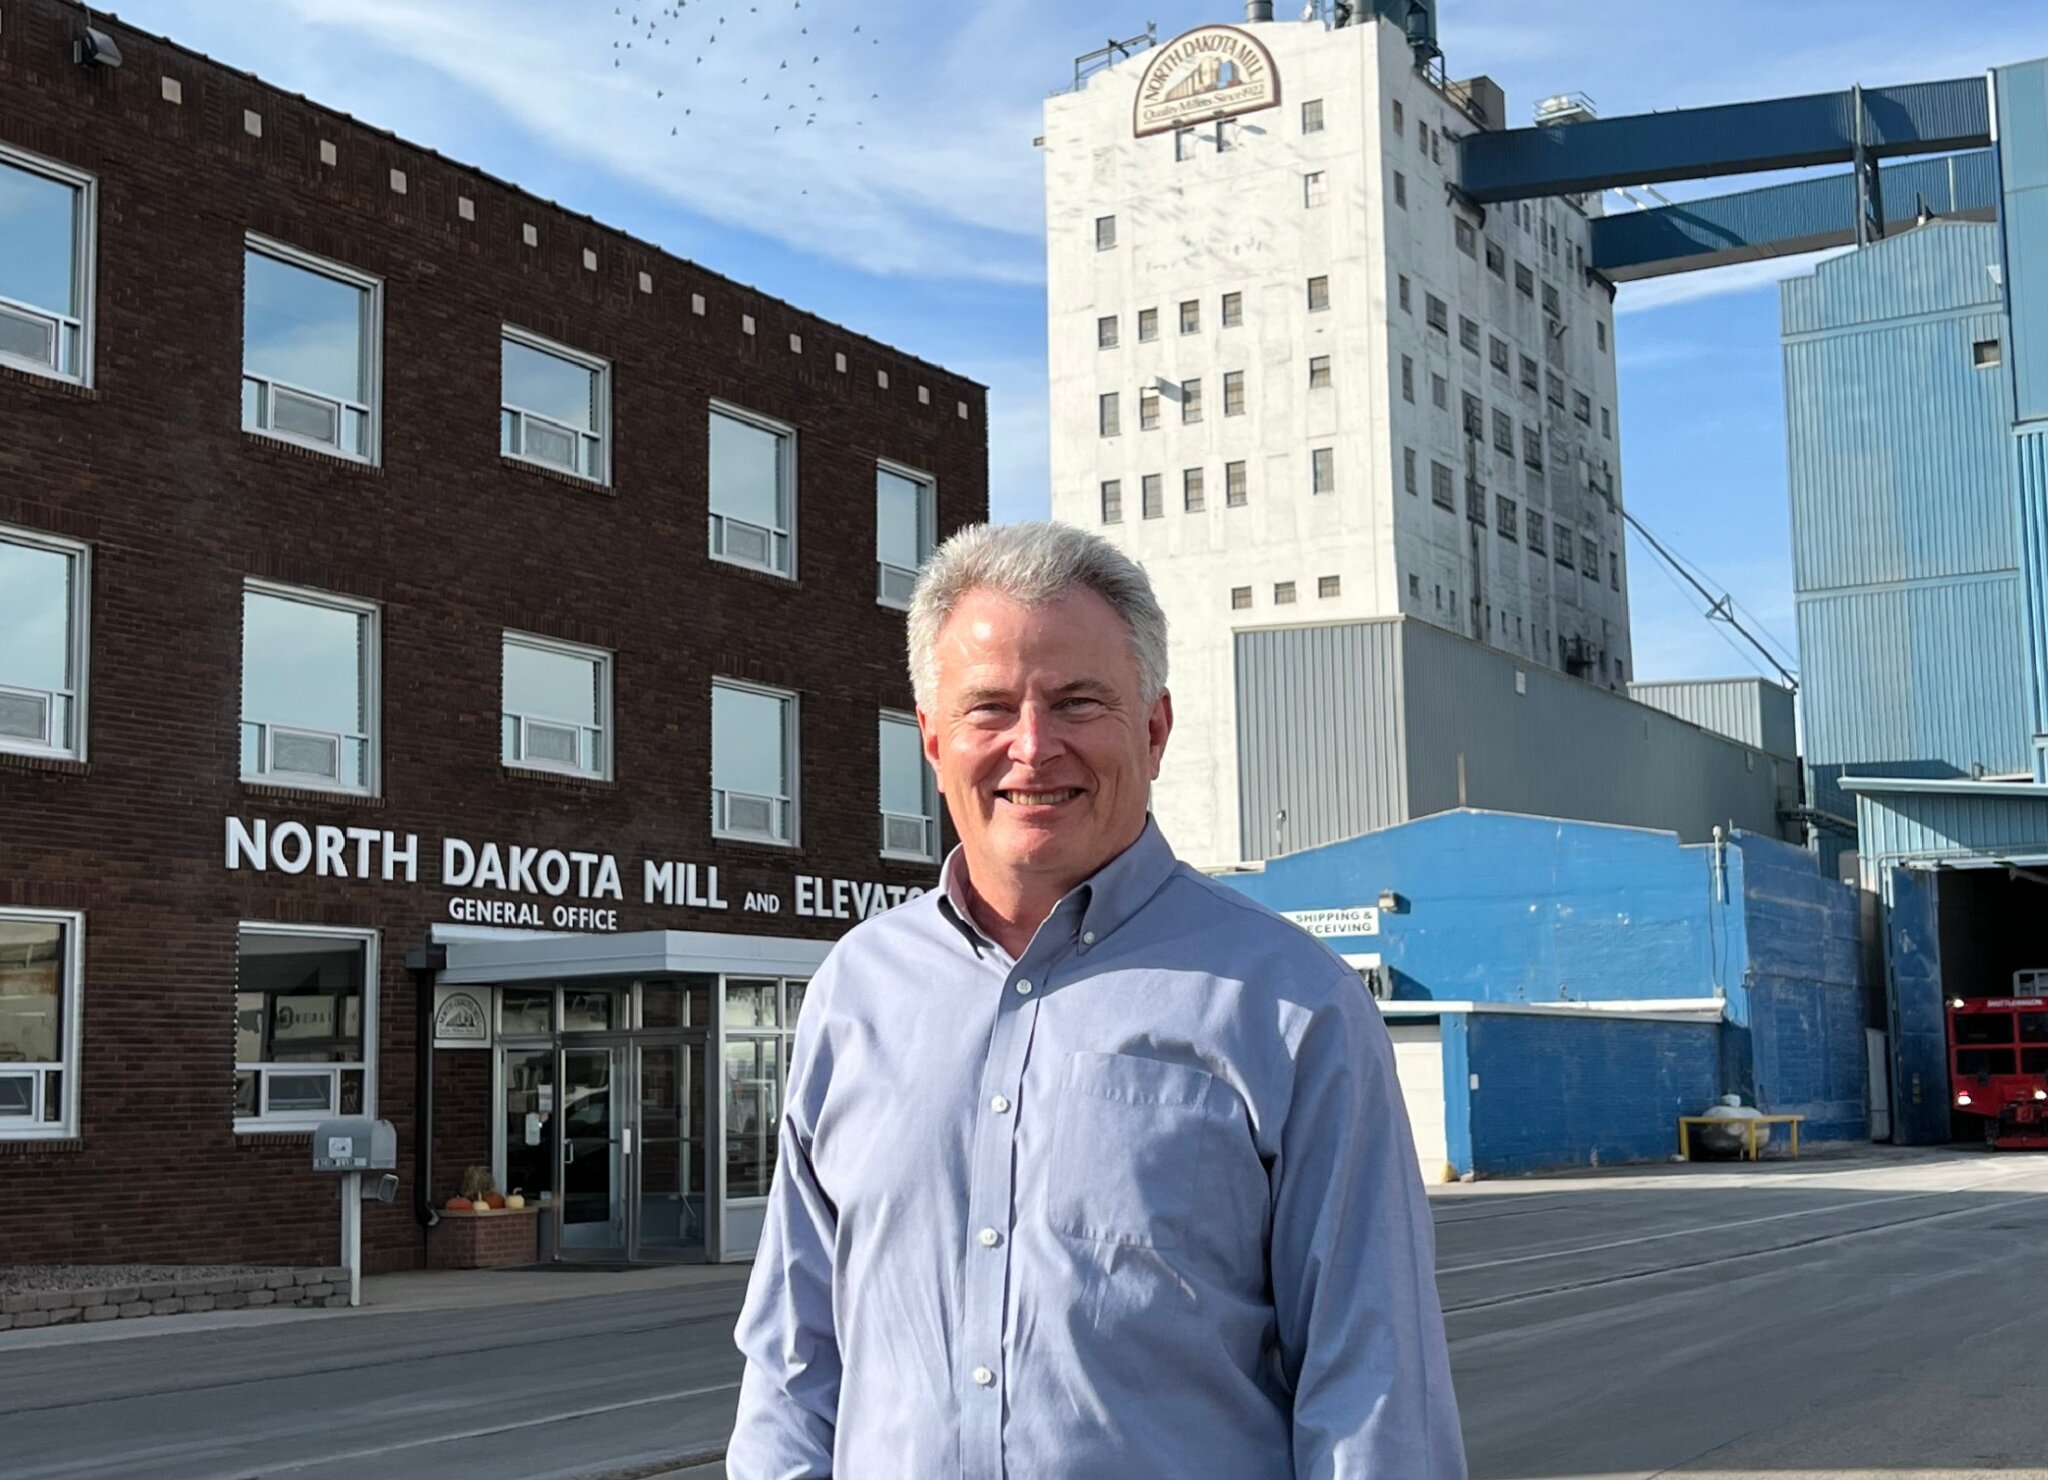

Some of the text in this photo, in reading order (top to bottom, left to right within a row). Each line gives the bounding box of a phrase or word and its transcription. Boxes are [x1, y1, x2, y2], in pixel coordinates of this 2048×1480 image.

[1143, 34, 1263, 101] NORTH DAKOTA MILL
[225, 816, 418, 883] NORTH
[442, 837, 624, 901] DAKOTA
[644, 859, 728, 910] MILL
[743, 891, 780, 914] AND
[449, 897, 617, 931] GENERAL OFFICE
[1296, 910, 1373, 923] SHIPPING &
[1304, 922, 1372, 934] ECEIVING
